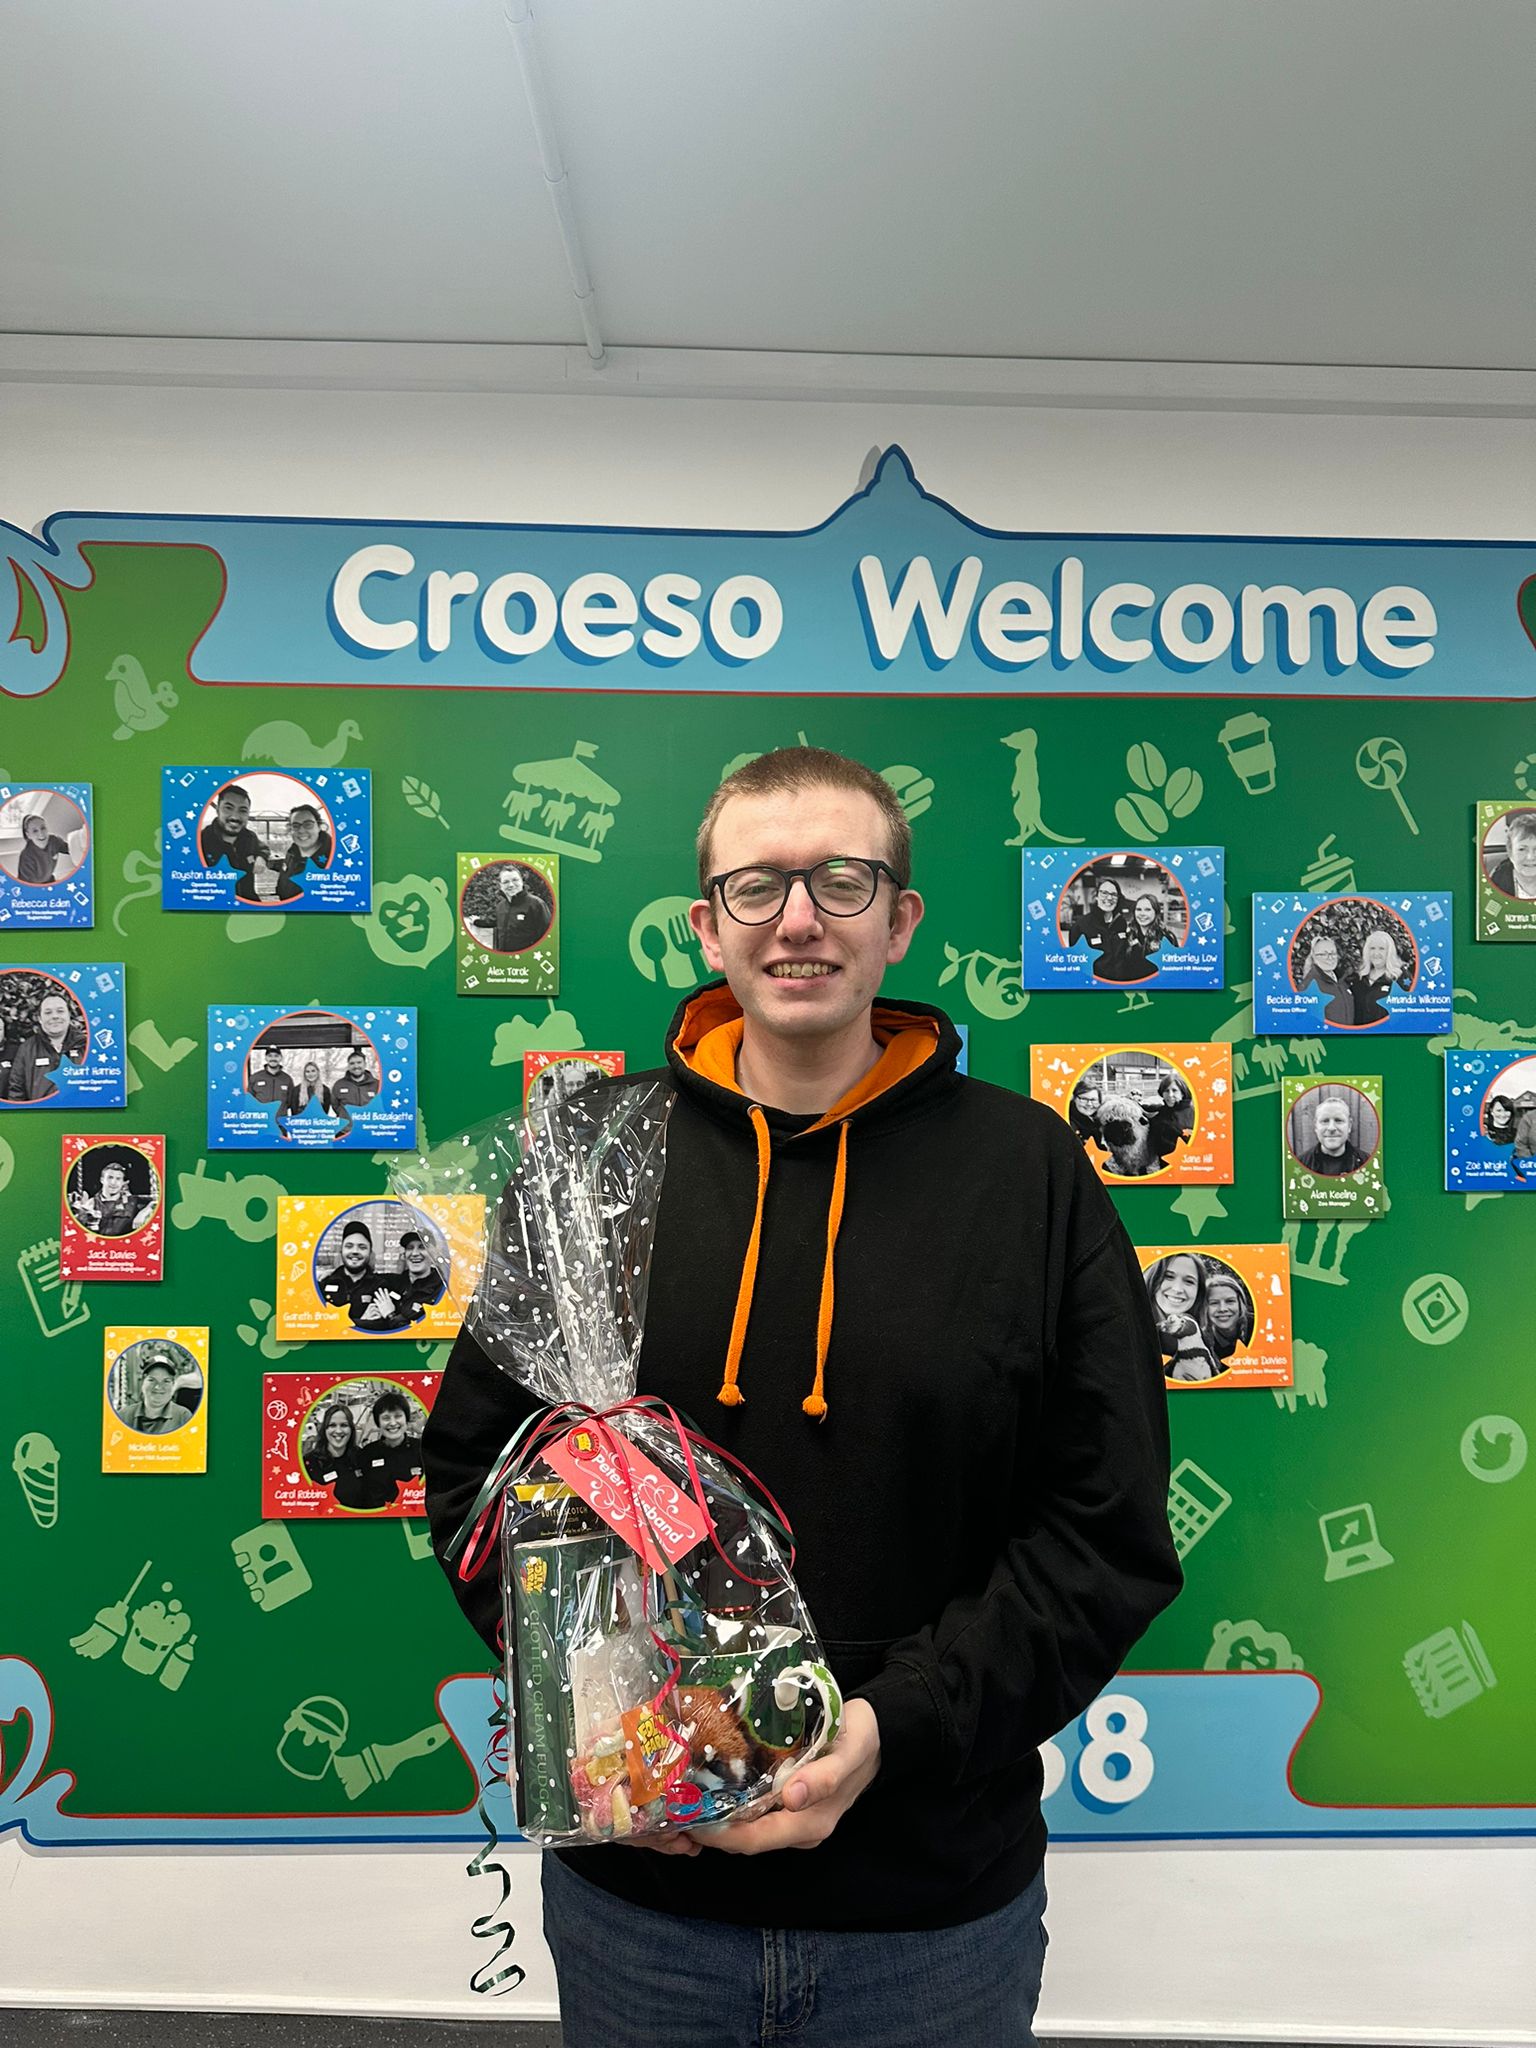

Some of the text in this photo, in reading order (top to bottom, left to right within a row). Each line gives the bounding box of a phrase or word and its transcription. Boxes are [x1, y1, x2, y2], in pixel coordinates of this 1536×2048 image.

[329, 543, 1438, 678] Croeso Welcome
[171, 870, 237, 881] Royston Badham
[305, 872, 361, 883] Emma Beynon
[11, 898, 47, 908] Rebecca
[1505, 914, 1529, 922] Norma
[1045, 953, 1064, 963] Kate
[1162, 953, 1218, 964] Kimberley Low
[487, 966, 504, 976] Alex
[1266, 995, 1318, 1004] Beckie Brown
[1386, 994, 1451, 1004] Amanda Wilkinson
[63, 1066, 121, 1076] Stuart Harries
[222, 1111, 268, 1120] Dan Gorman
[352, 1112, 413, 1122] Hedd Bazalgette
[285, 1117, 311, 1126] Jemma
[1182, 1154, 1200, 1164] Jane
[1483, 1161, 1507, 1171] Wright
[1310, 1189, 1357, 1201] Alan Keeling
[87, 1250, 137, 1260] Jack Davies
[283, 1311, 340, 1321] Gareth Brown
[430, 1310, 446, 1319] Ben
[1229, 1355, 1287, 1365] Caroline Davies
[591, 1454, 627, 1487] Peter
[274, 1489, 328, 1499] Carol Robbins
[402, 1488, 426, 1499] Angel
[529, 1609, 543, 1686] CLOTTED
[533, 1690, 546, 1748] CREAM
